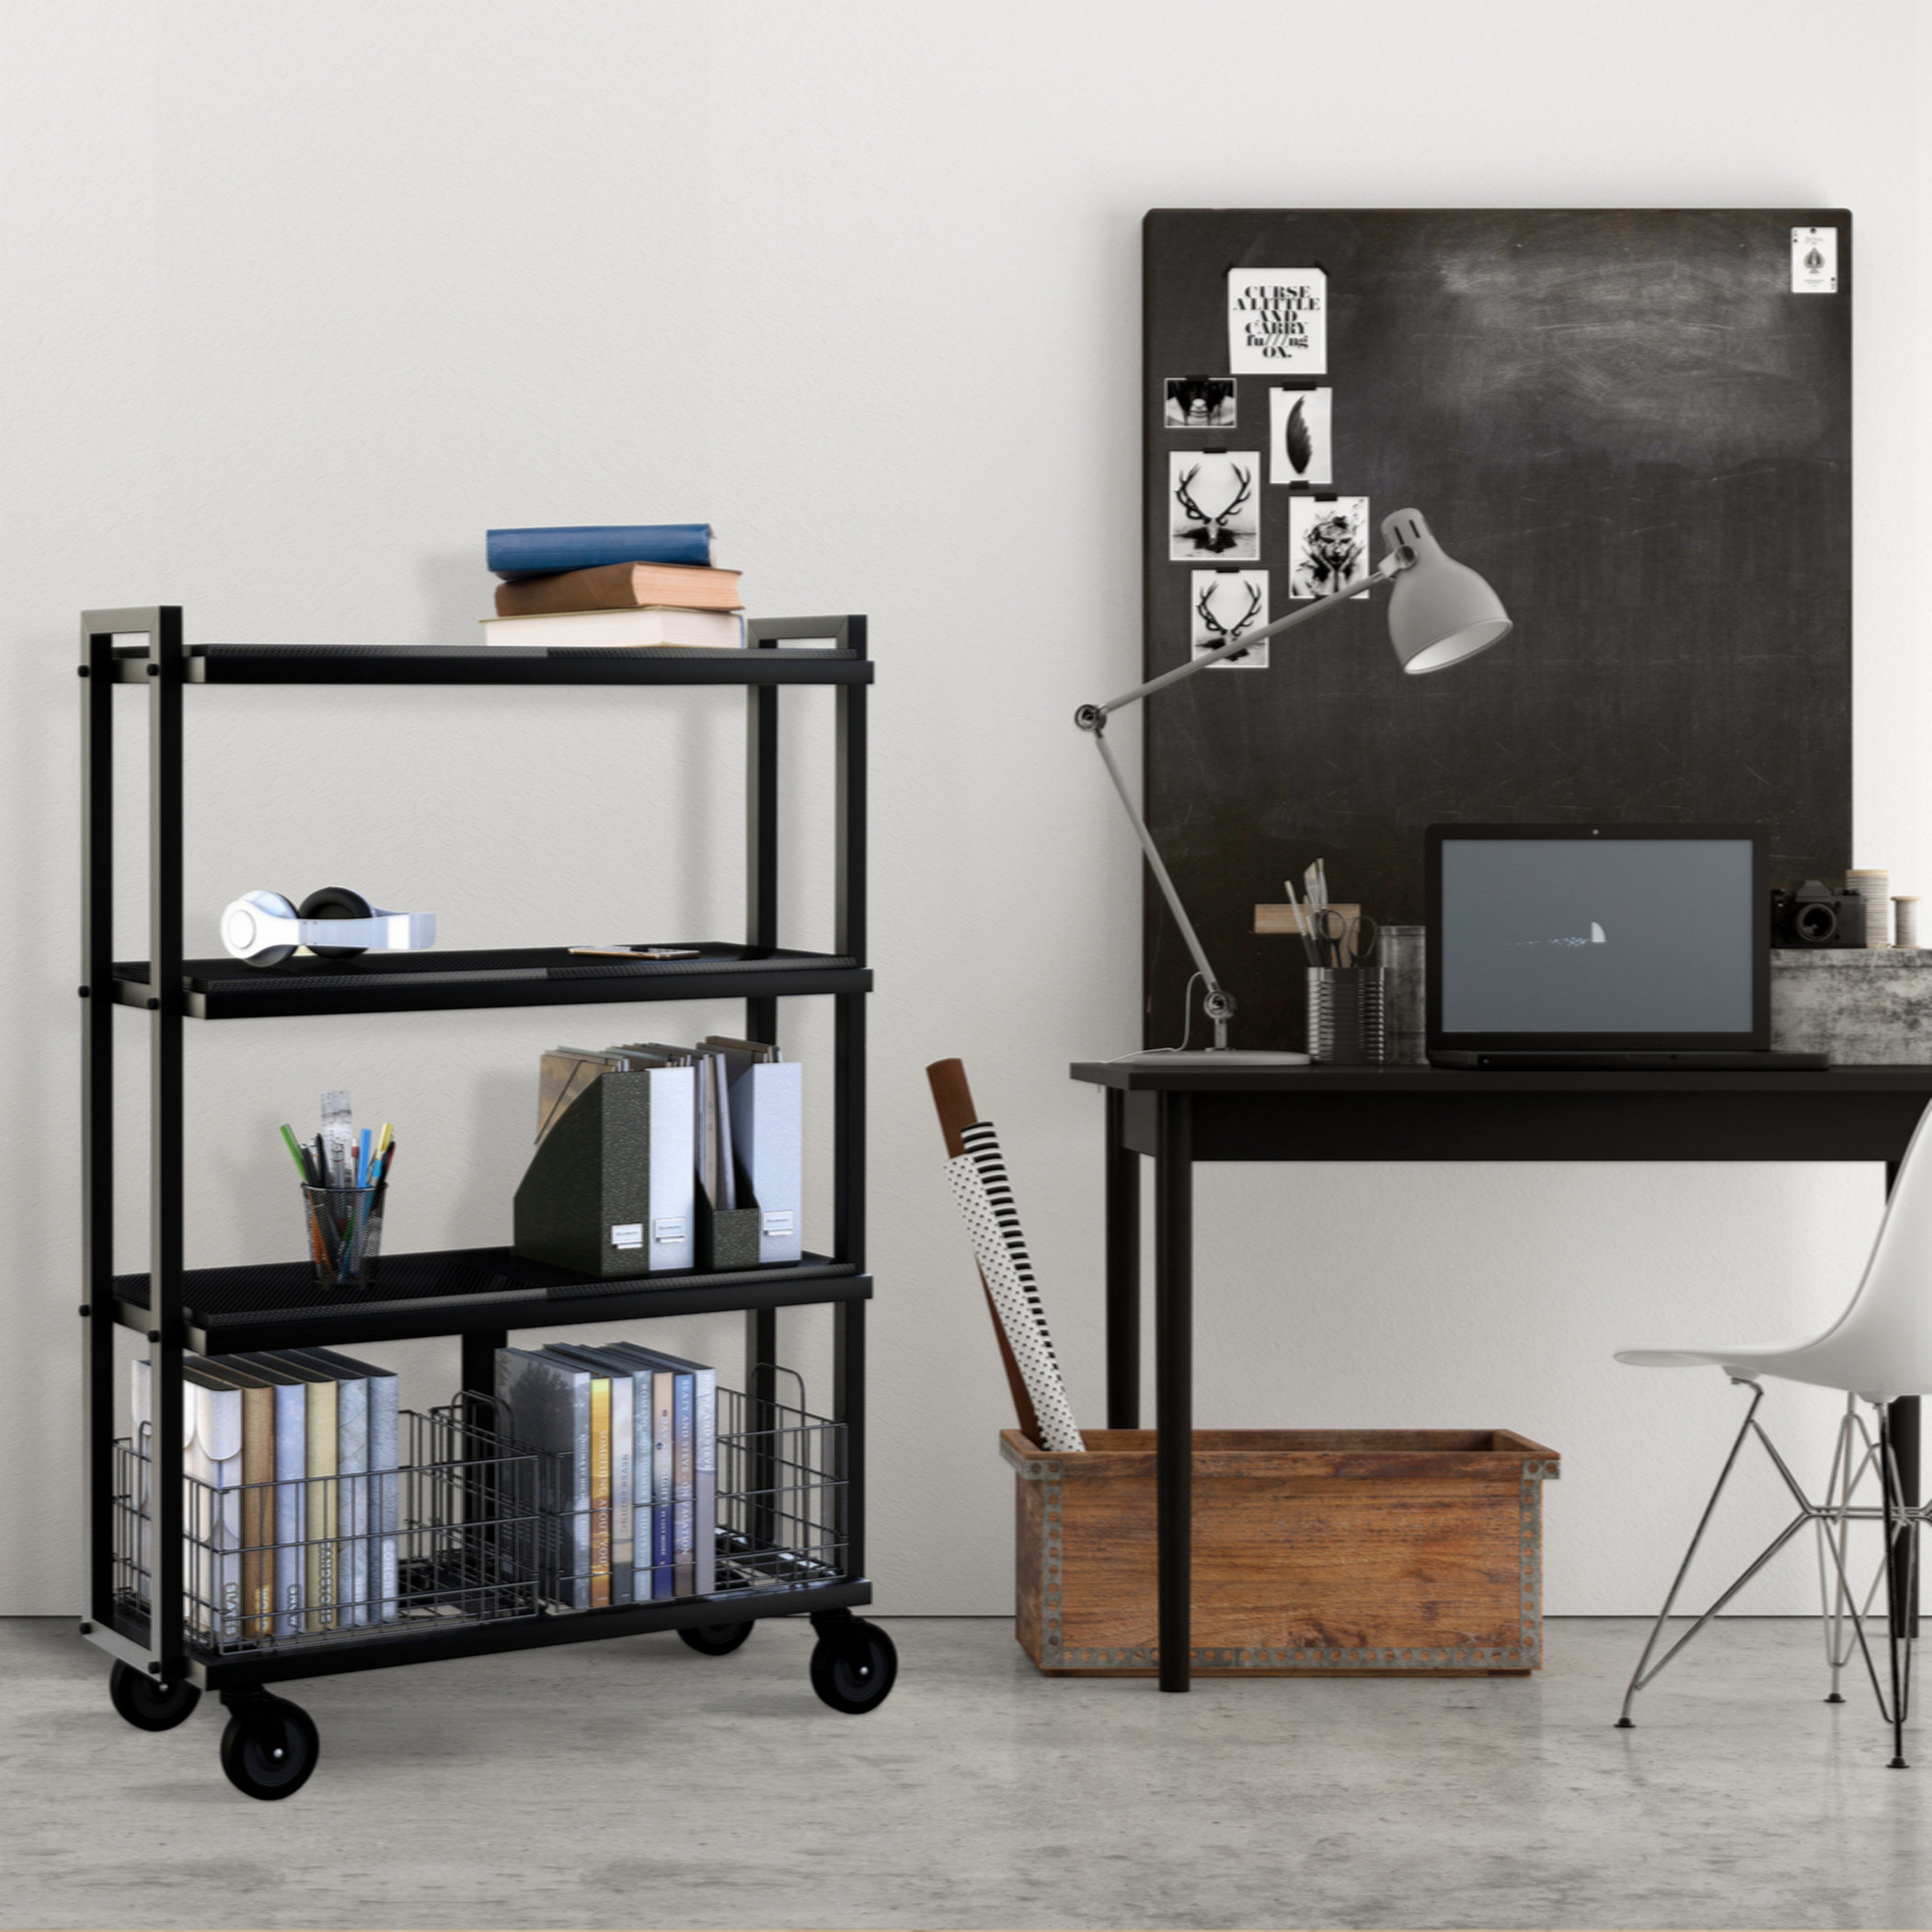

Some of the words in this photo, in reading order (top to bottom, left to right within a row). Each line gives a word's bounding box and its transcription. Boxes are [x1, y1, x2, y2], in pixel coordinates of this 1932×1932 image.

[1244, 285, 1311, 298] CURSE
[1250, 298, 1321, 310] LITTLE
[1245, 322, 1308, 334] CARRY
[1256, 310, 1298, 322] AND
[661, 1416, 670, 1438] DAY
[681, 1415, 690, 1438] AND
[598, 1430, 608, 1496] SOMETHING
[681, 1440, 690, 1473] STEVE
[620, 1454, 630, 1488] NEVER
[598, 1499, 608, 1535] ABOUT
[620, 1490, 630, 1533] ENDING
[681, 1501, 690, 1555] VACATION
[598, 1539, 608, 1563] YOU
[383, 1542, 394, 1615] CONCREE
